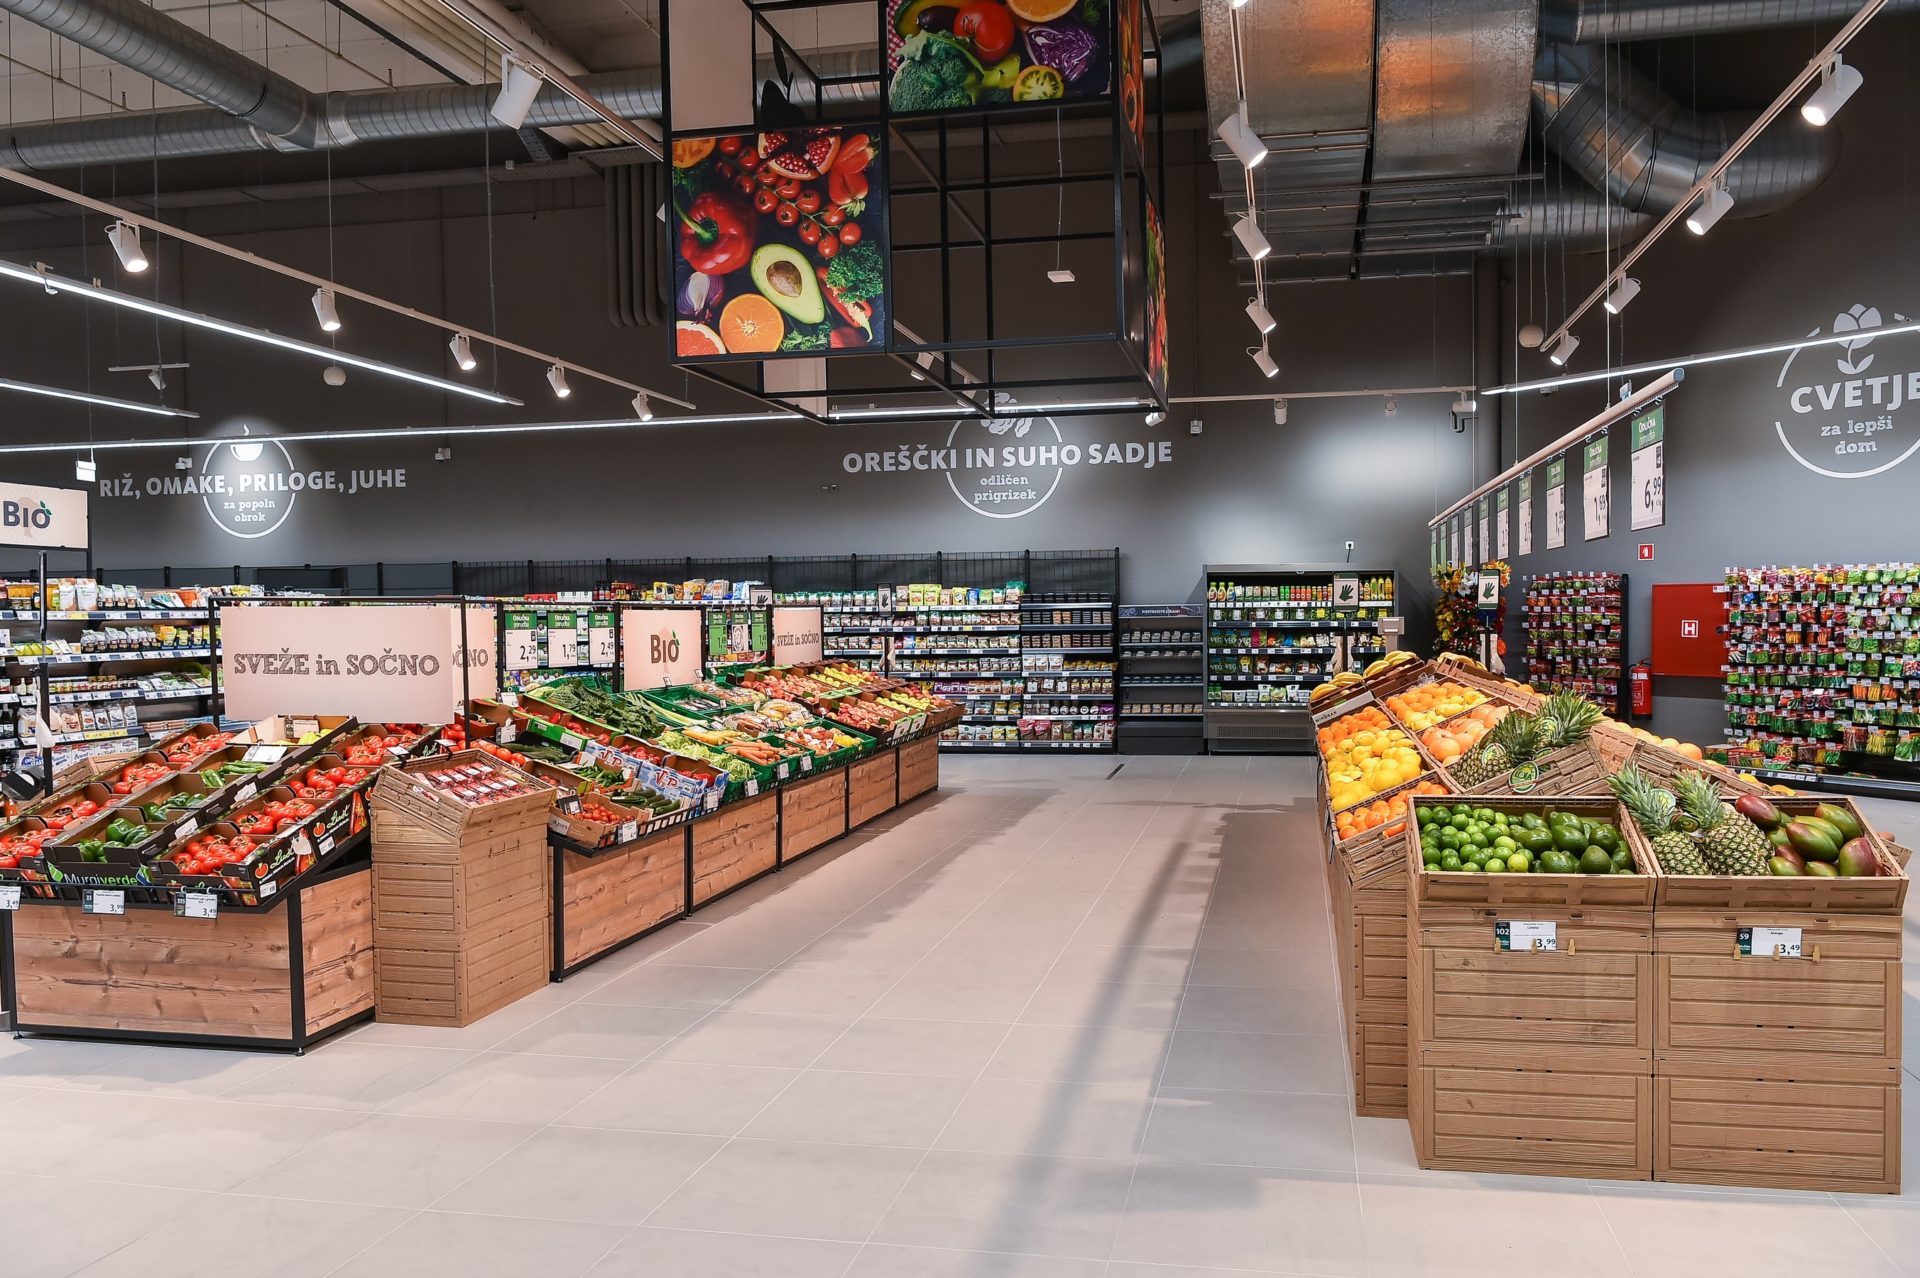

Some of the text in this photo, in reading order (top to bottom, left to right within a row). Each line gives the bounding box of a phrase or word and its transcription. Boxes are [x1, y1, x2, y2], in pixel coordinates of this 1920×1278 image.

[1790, 371, 1920, 414] CVETJE
[1820, 415, 1894, 437] za lepši
[1834, 440, 1878, 455] dom
[842, 441, 1172, 473] OREŠČKI IN SUHO SADJE
[99, 468, 407, 500] RIŽ, OMAKE, PRILOGE, JUHE
[980, 474, 1029, 486] odličen
[973, 489, 1037, 504] prigrizek
[1644, 476, 1662, 513] 6,99
[223, 499, 276, 512] za popoln
[3, 500, 51, 529] BIO
[234, 512, 266, 522] obrok
[1684, 622, 1696, 635] H
[650, 634, 680, 664] BIO
[233, 647, 440, 676] SVEŽE in SOČNO
[64, 873, 138, 886] Murgiverde
[1496, 928, 1510, 936] 102
[1536, 938, 1556, 950] 3,99
[1780, 943, 1800, 956] 3,49
